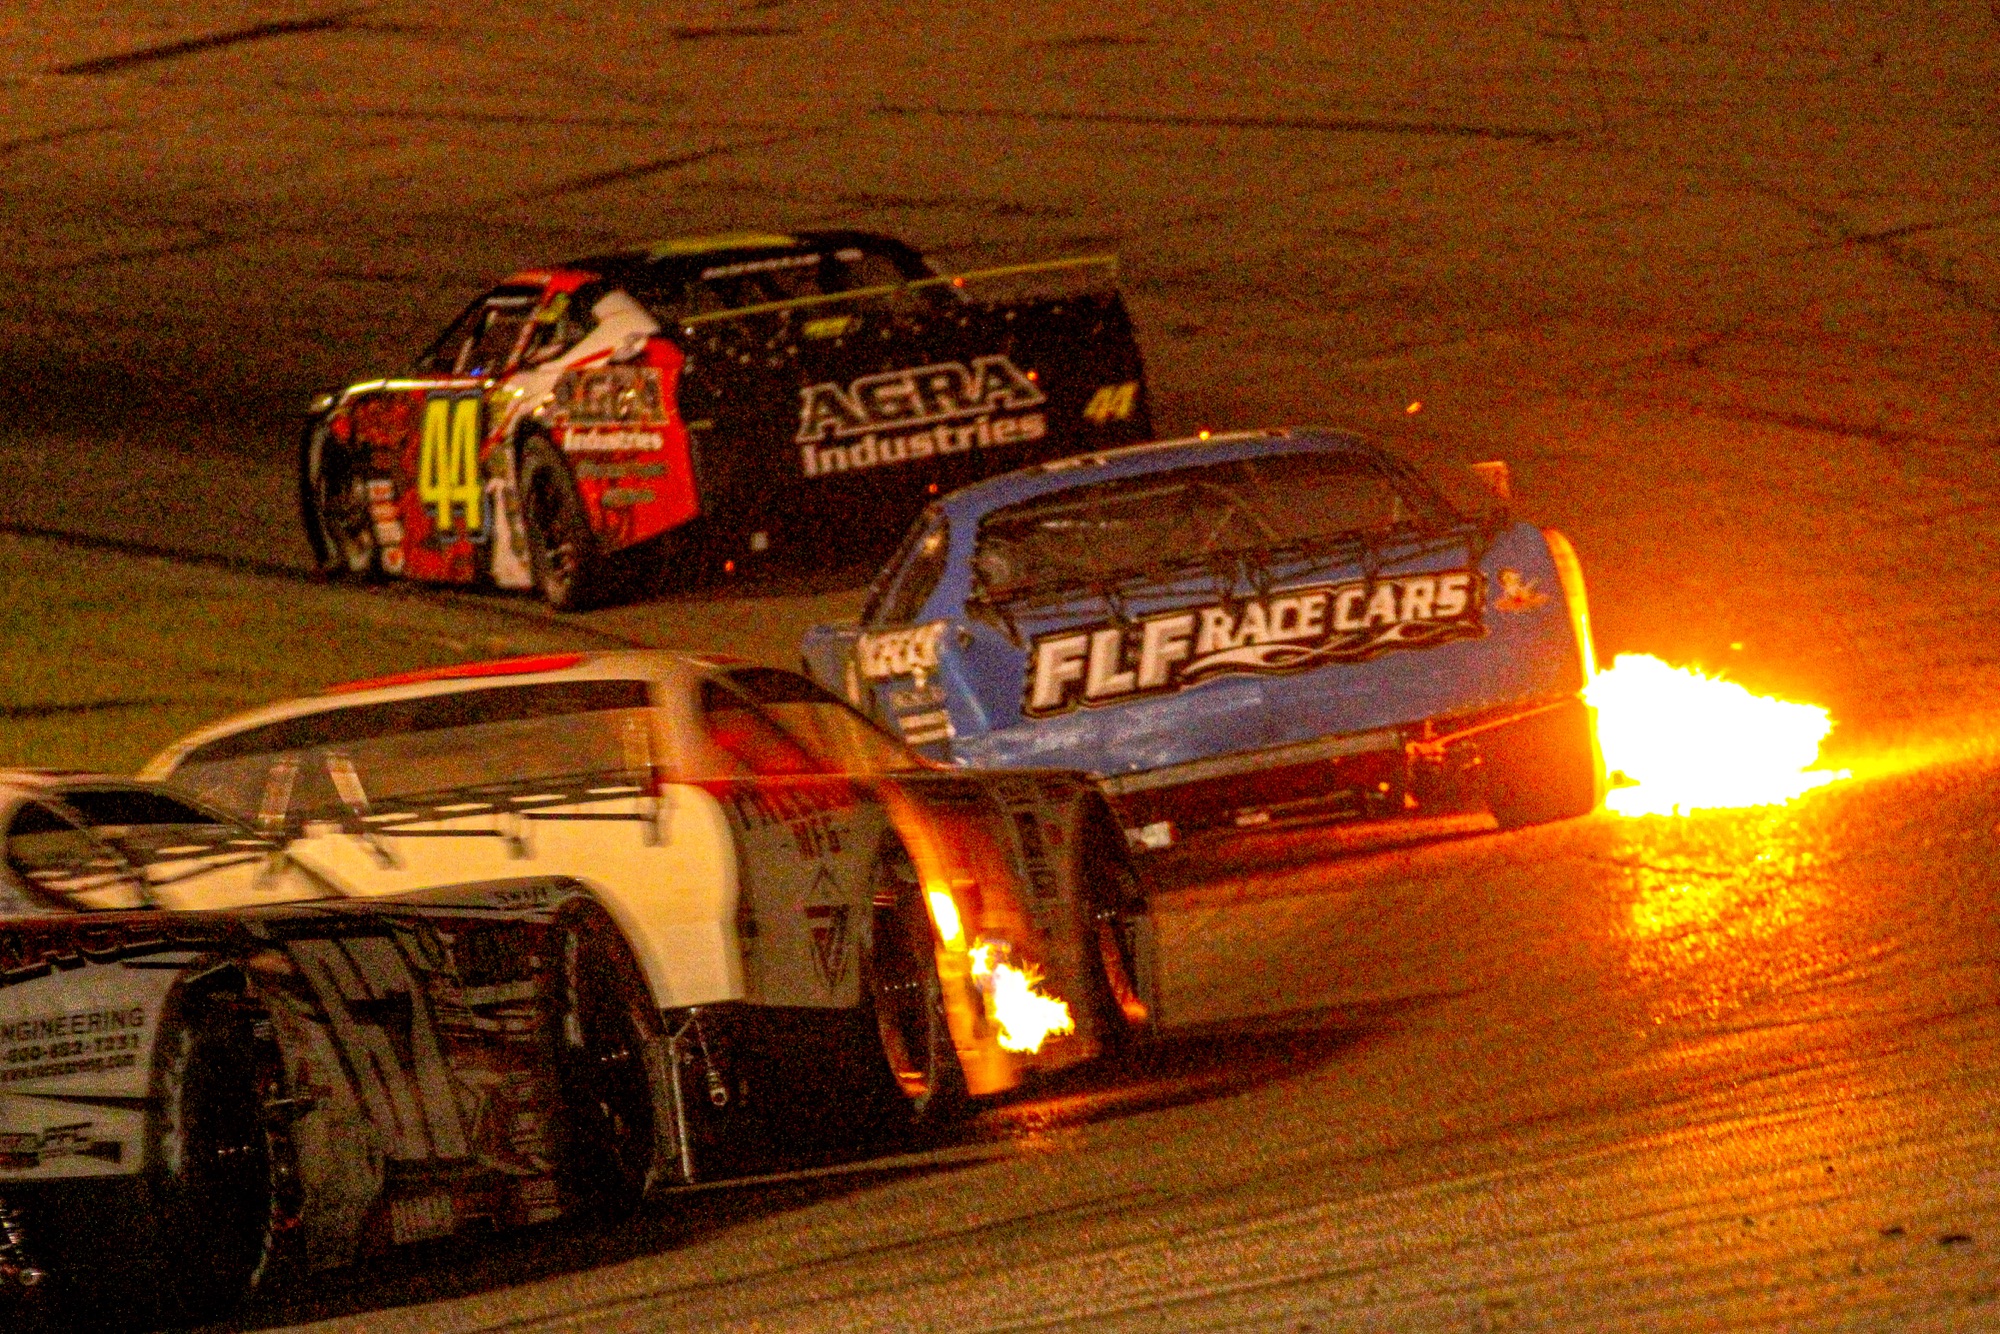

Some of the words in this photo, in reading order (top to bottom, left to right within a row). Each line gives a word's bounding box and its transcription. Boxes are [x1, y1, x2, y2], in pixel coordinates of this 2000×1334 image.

[795, 355, 1047, 445] AGRA
[1084, 381, 1139, 424] 44
[419, 396, 484, 533] 44
[802, 414, 1047, 478] Industries
[1032, 615, 1197, 712] FLF
[1199, 594, 1326, 652] RACE
[1332, 575, 1471, 633] CARS
